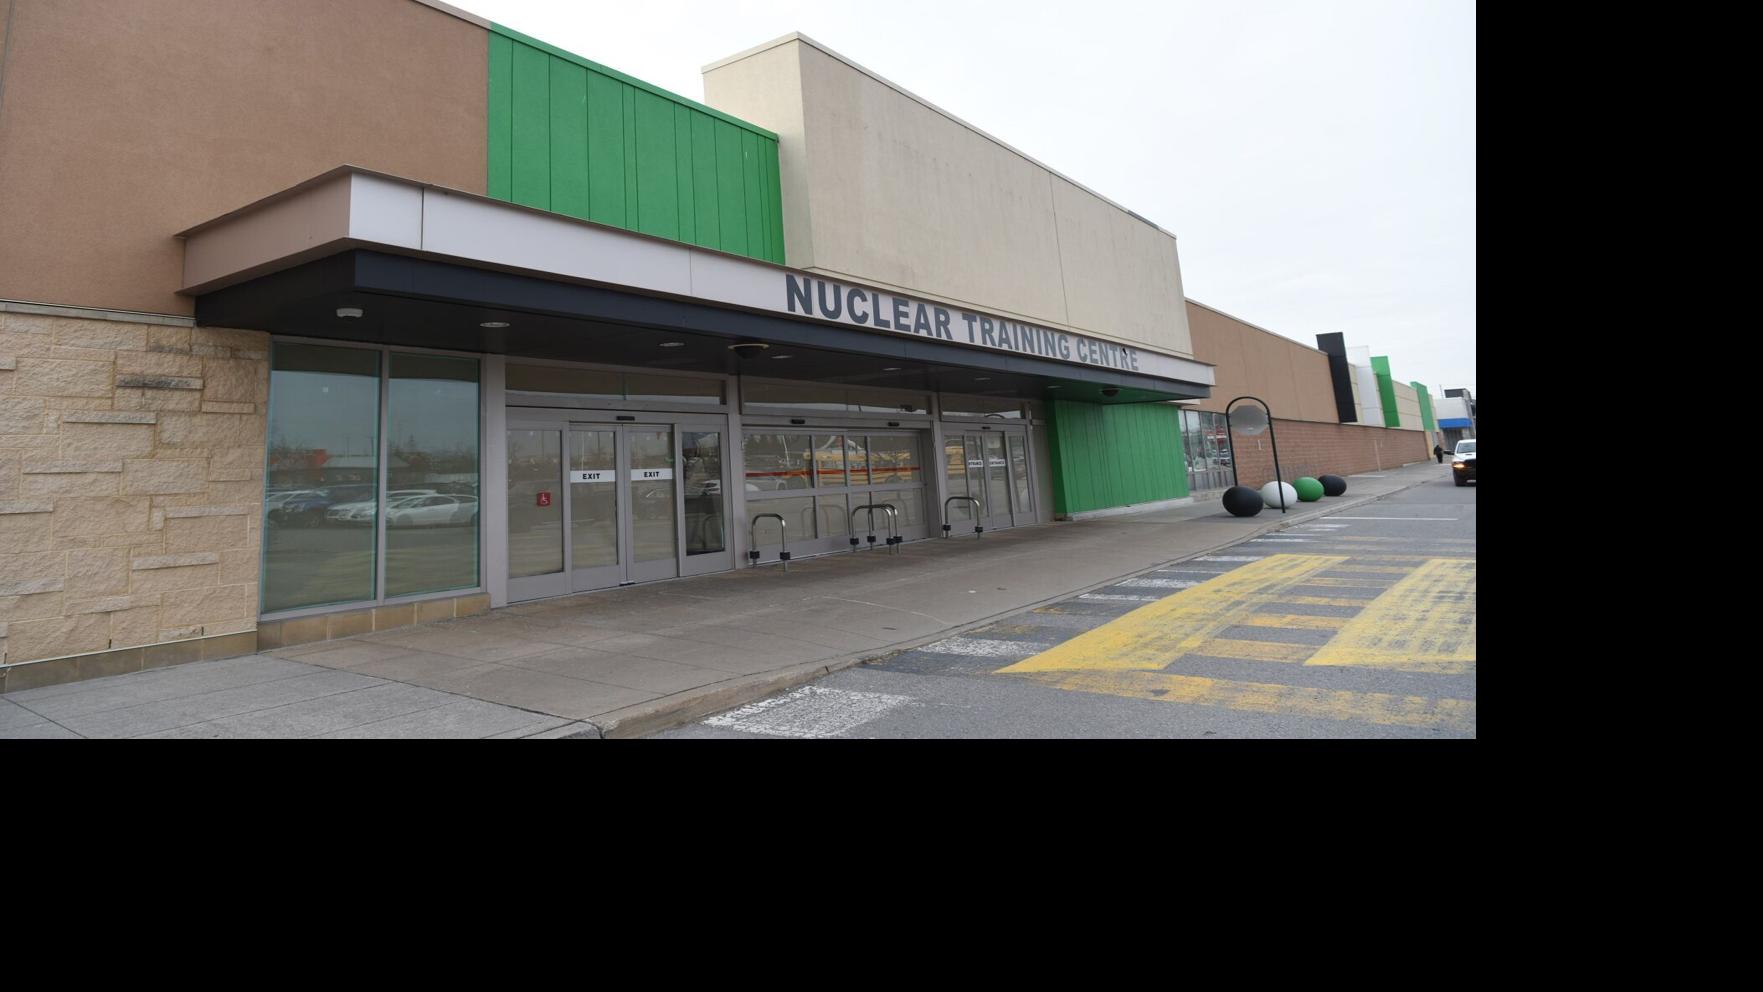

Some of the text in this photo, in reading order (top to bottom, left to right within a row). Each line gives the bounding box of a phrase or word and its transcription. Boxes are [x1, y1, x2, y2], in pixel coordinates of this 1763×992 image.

[786, 273, 1140, 372] NUCLEAR TRAINING CENTRE
